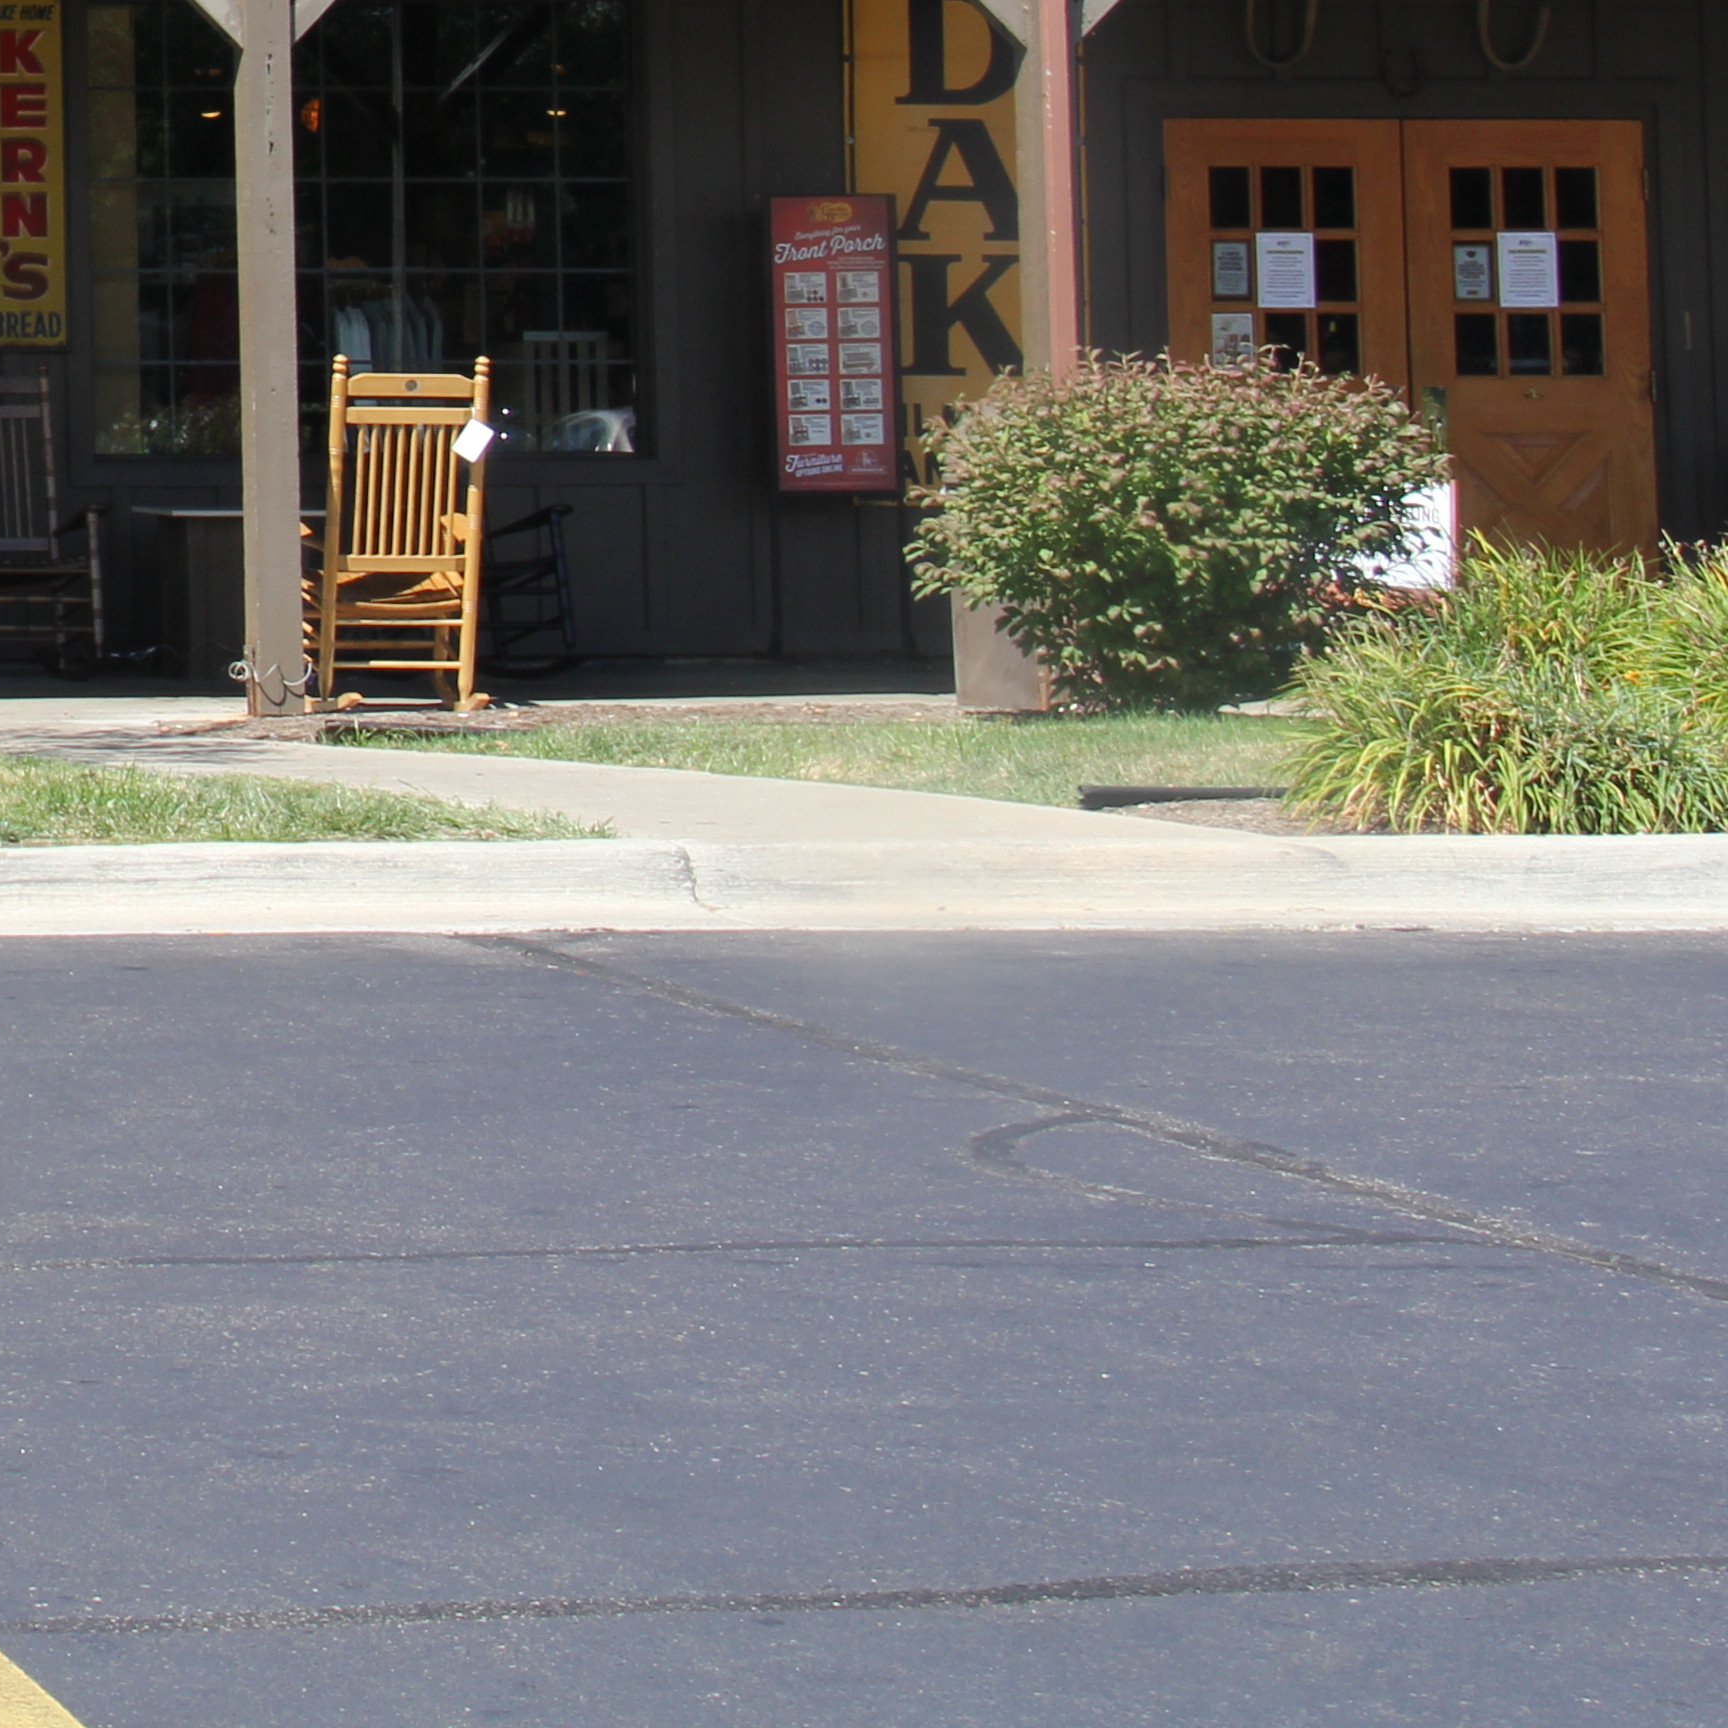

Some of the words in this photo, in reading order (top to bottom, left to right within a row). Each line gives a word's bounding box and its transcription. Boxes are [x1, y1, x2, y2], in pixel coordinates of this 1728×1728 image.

[20, 3, 55, 21] HOME
[774, 240, 828, 264] Front
[829, 233, 887, 255] Porch
